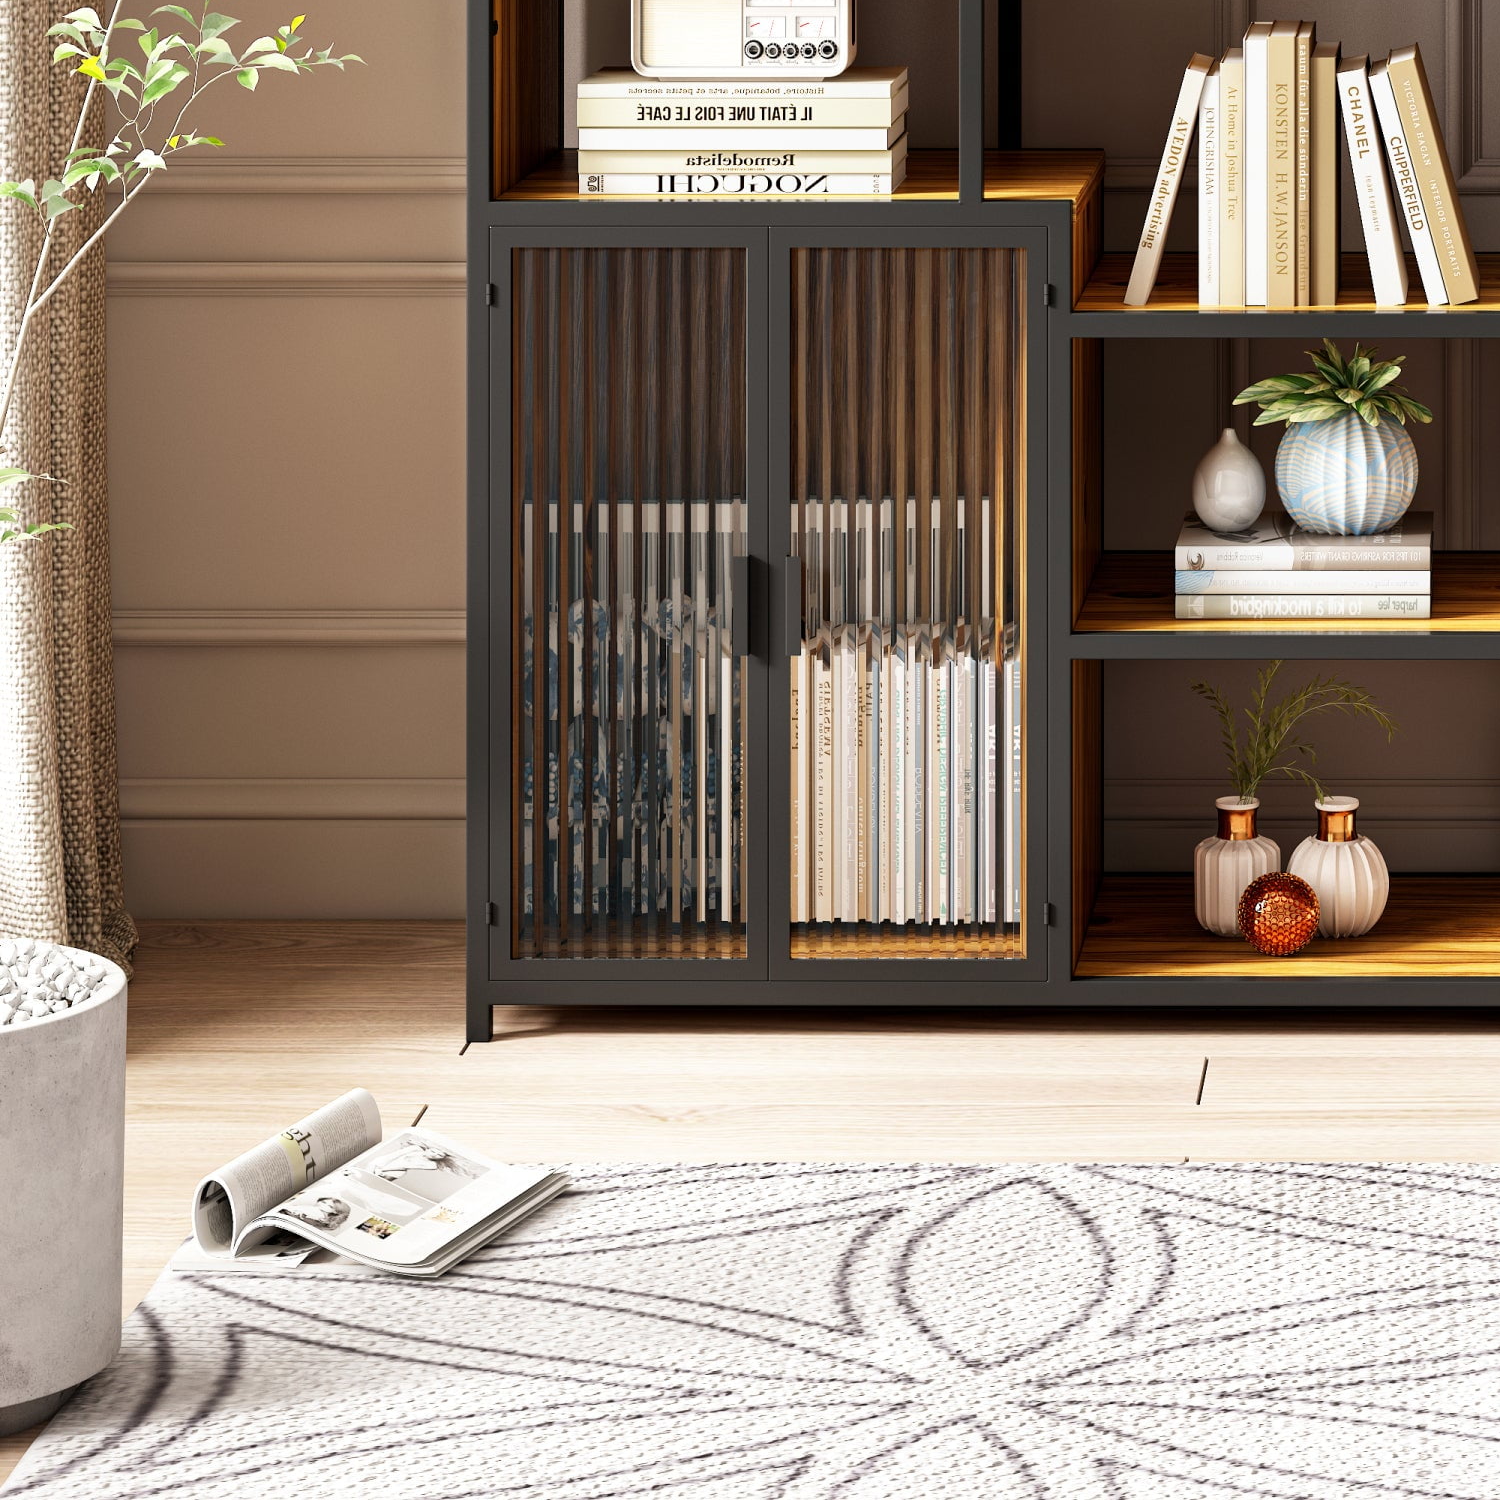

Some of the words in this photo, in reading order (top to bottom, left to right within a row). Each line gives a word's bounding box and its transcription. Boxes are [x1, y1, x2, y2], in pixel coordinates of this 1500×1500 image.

[1228, 86, 1236, 99] At
[1298, 79, 1306, 96] für
[1228, 104, 1236, 137] Home
[1275, 83, 1288, 160] KONSTEN
[1298, 100, 1306, 122] alla
[1348, 85, 1370, 159] CHANEL
[1164, 116, 1189, 183] AVEDON
[1228, 139, 1236, 151] in
[1298, 126, 1306, 144] die
[1226, 154, 1236, 192] Joshua
[1298, 148, 1306, 201] sünderin
[1390, 136, 1424, 232] CHIPPERFIELD
[1141, 178, 1171, 250] advertising
[1228, 196, 1236, 221] Tree
[1275, 172, 1288, 276] H.W.JANSON
